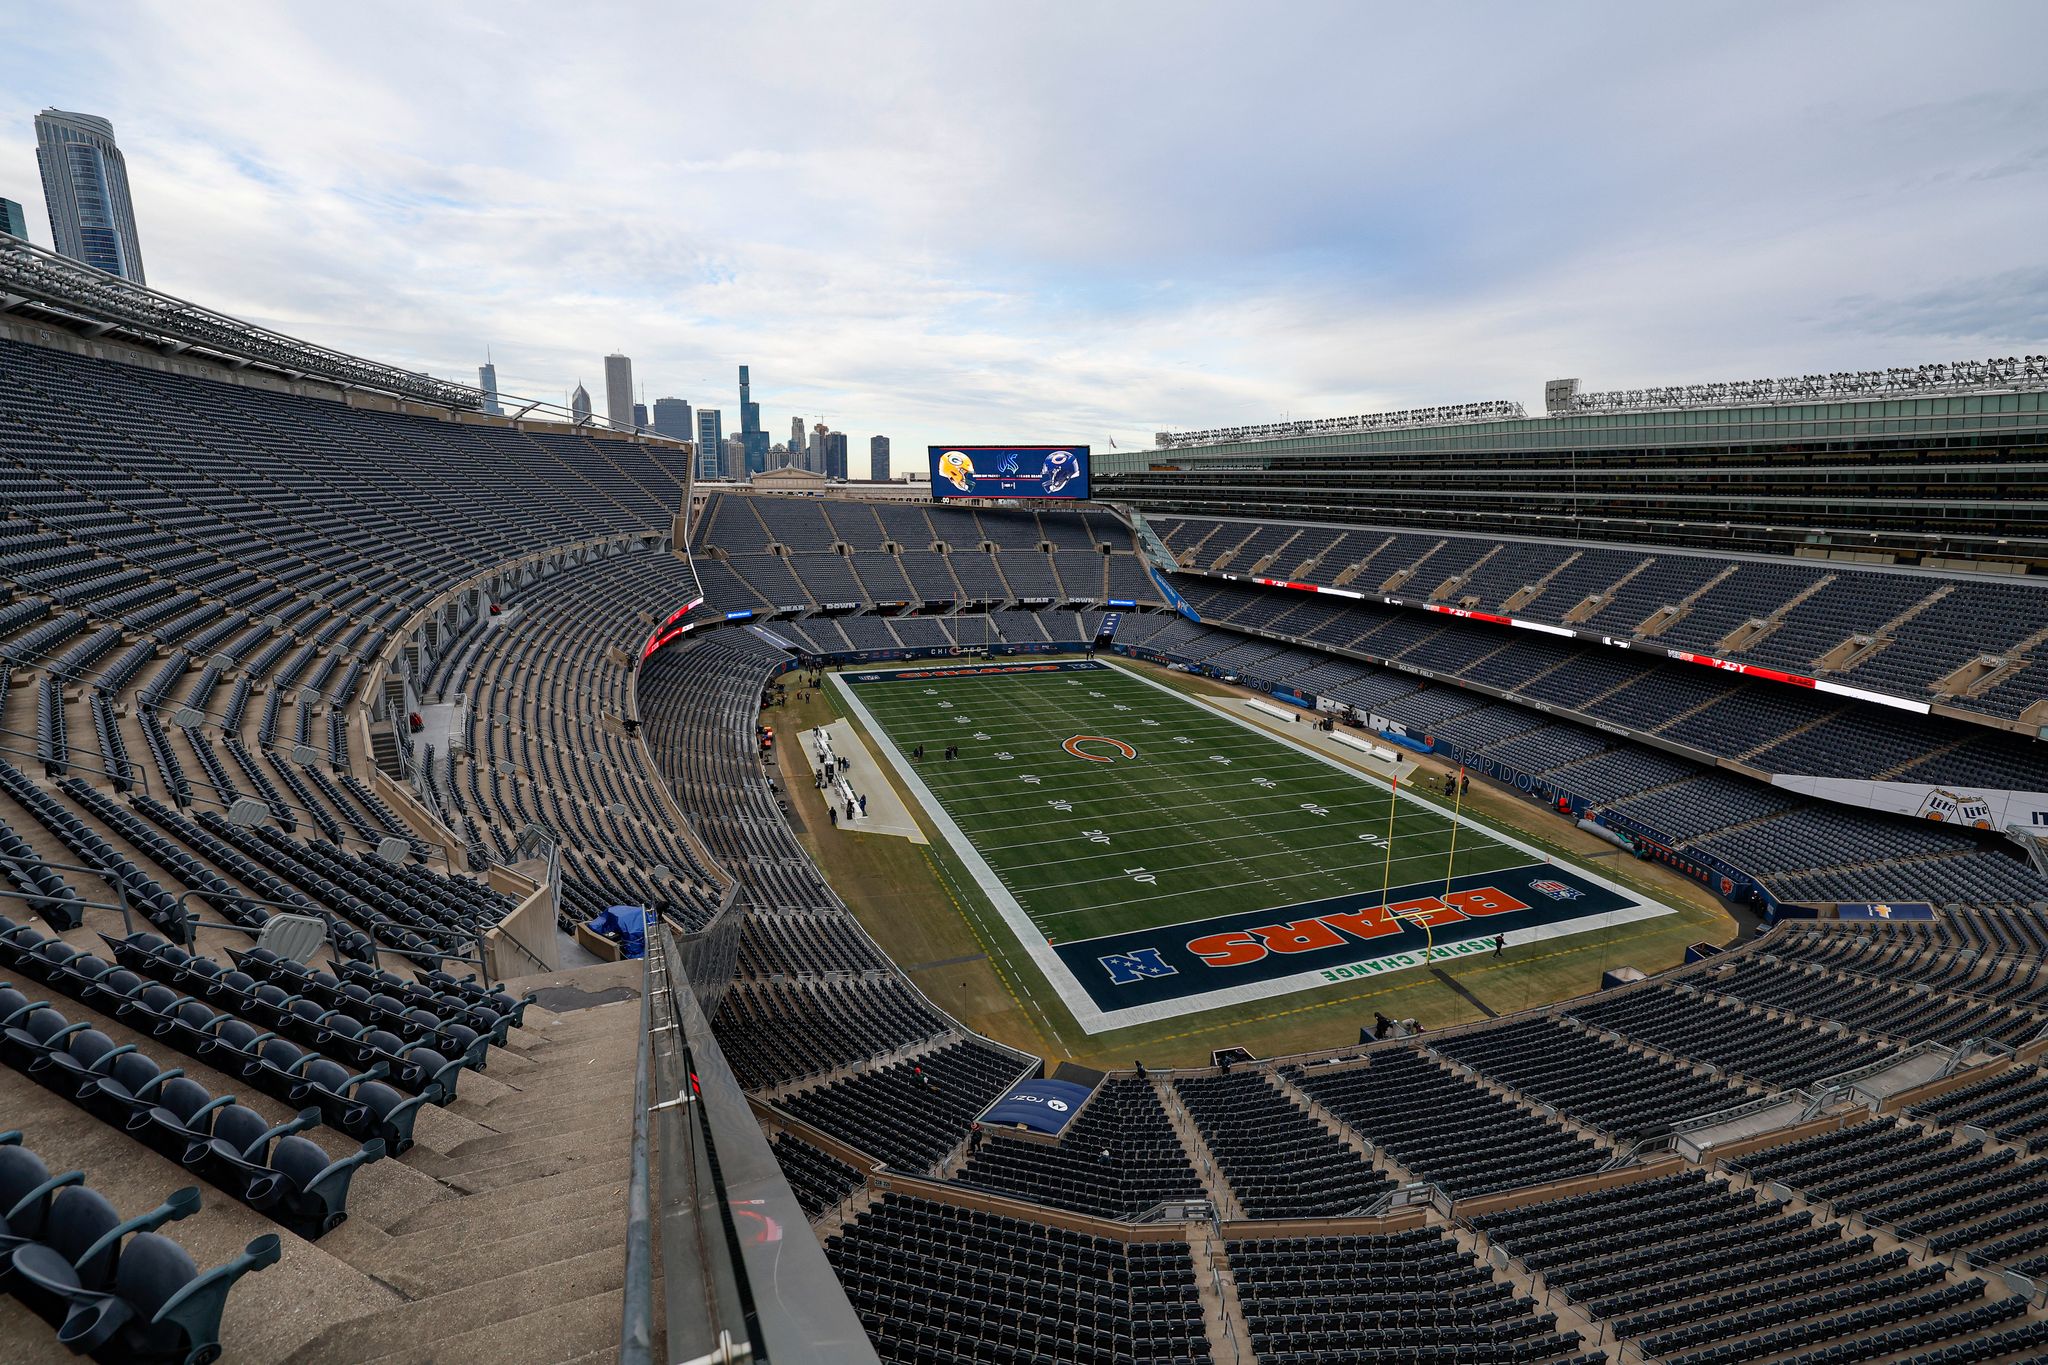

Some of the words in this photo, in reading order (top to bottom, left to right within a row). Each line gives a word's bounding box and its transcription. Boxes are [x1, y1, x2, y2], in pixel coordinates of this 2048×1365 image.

[1399, 664, 1419, 675] SOLDIER
[1420, 668, 1434, 678] FIELD
[1595, 721, 1630, 737] ticketmaster
[1450, 743, 1495, 777] BEAR
[1251, 777, 1277, 788] 30
[1047, 799, 1072, 811] 30
[1300, 803, 1330, 815] 20
[1929, 797, 1955, 811] Lite
[1963, 805, 1988, 820] Lite
[1081, 829, 1110, 843] 20
[1358, 834, 1389, 848] 10
[1123, 867, 1156, 883] 10
[1186, 886, 1533, 967] BEARS
[1418, 936, 1498, 961] NSPIRE
[1320, 955, 1416, 981] CHANGE
[1009, 1095, 1044, 1103] razr
